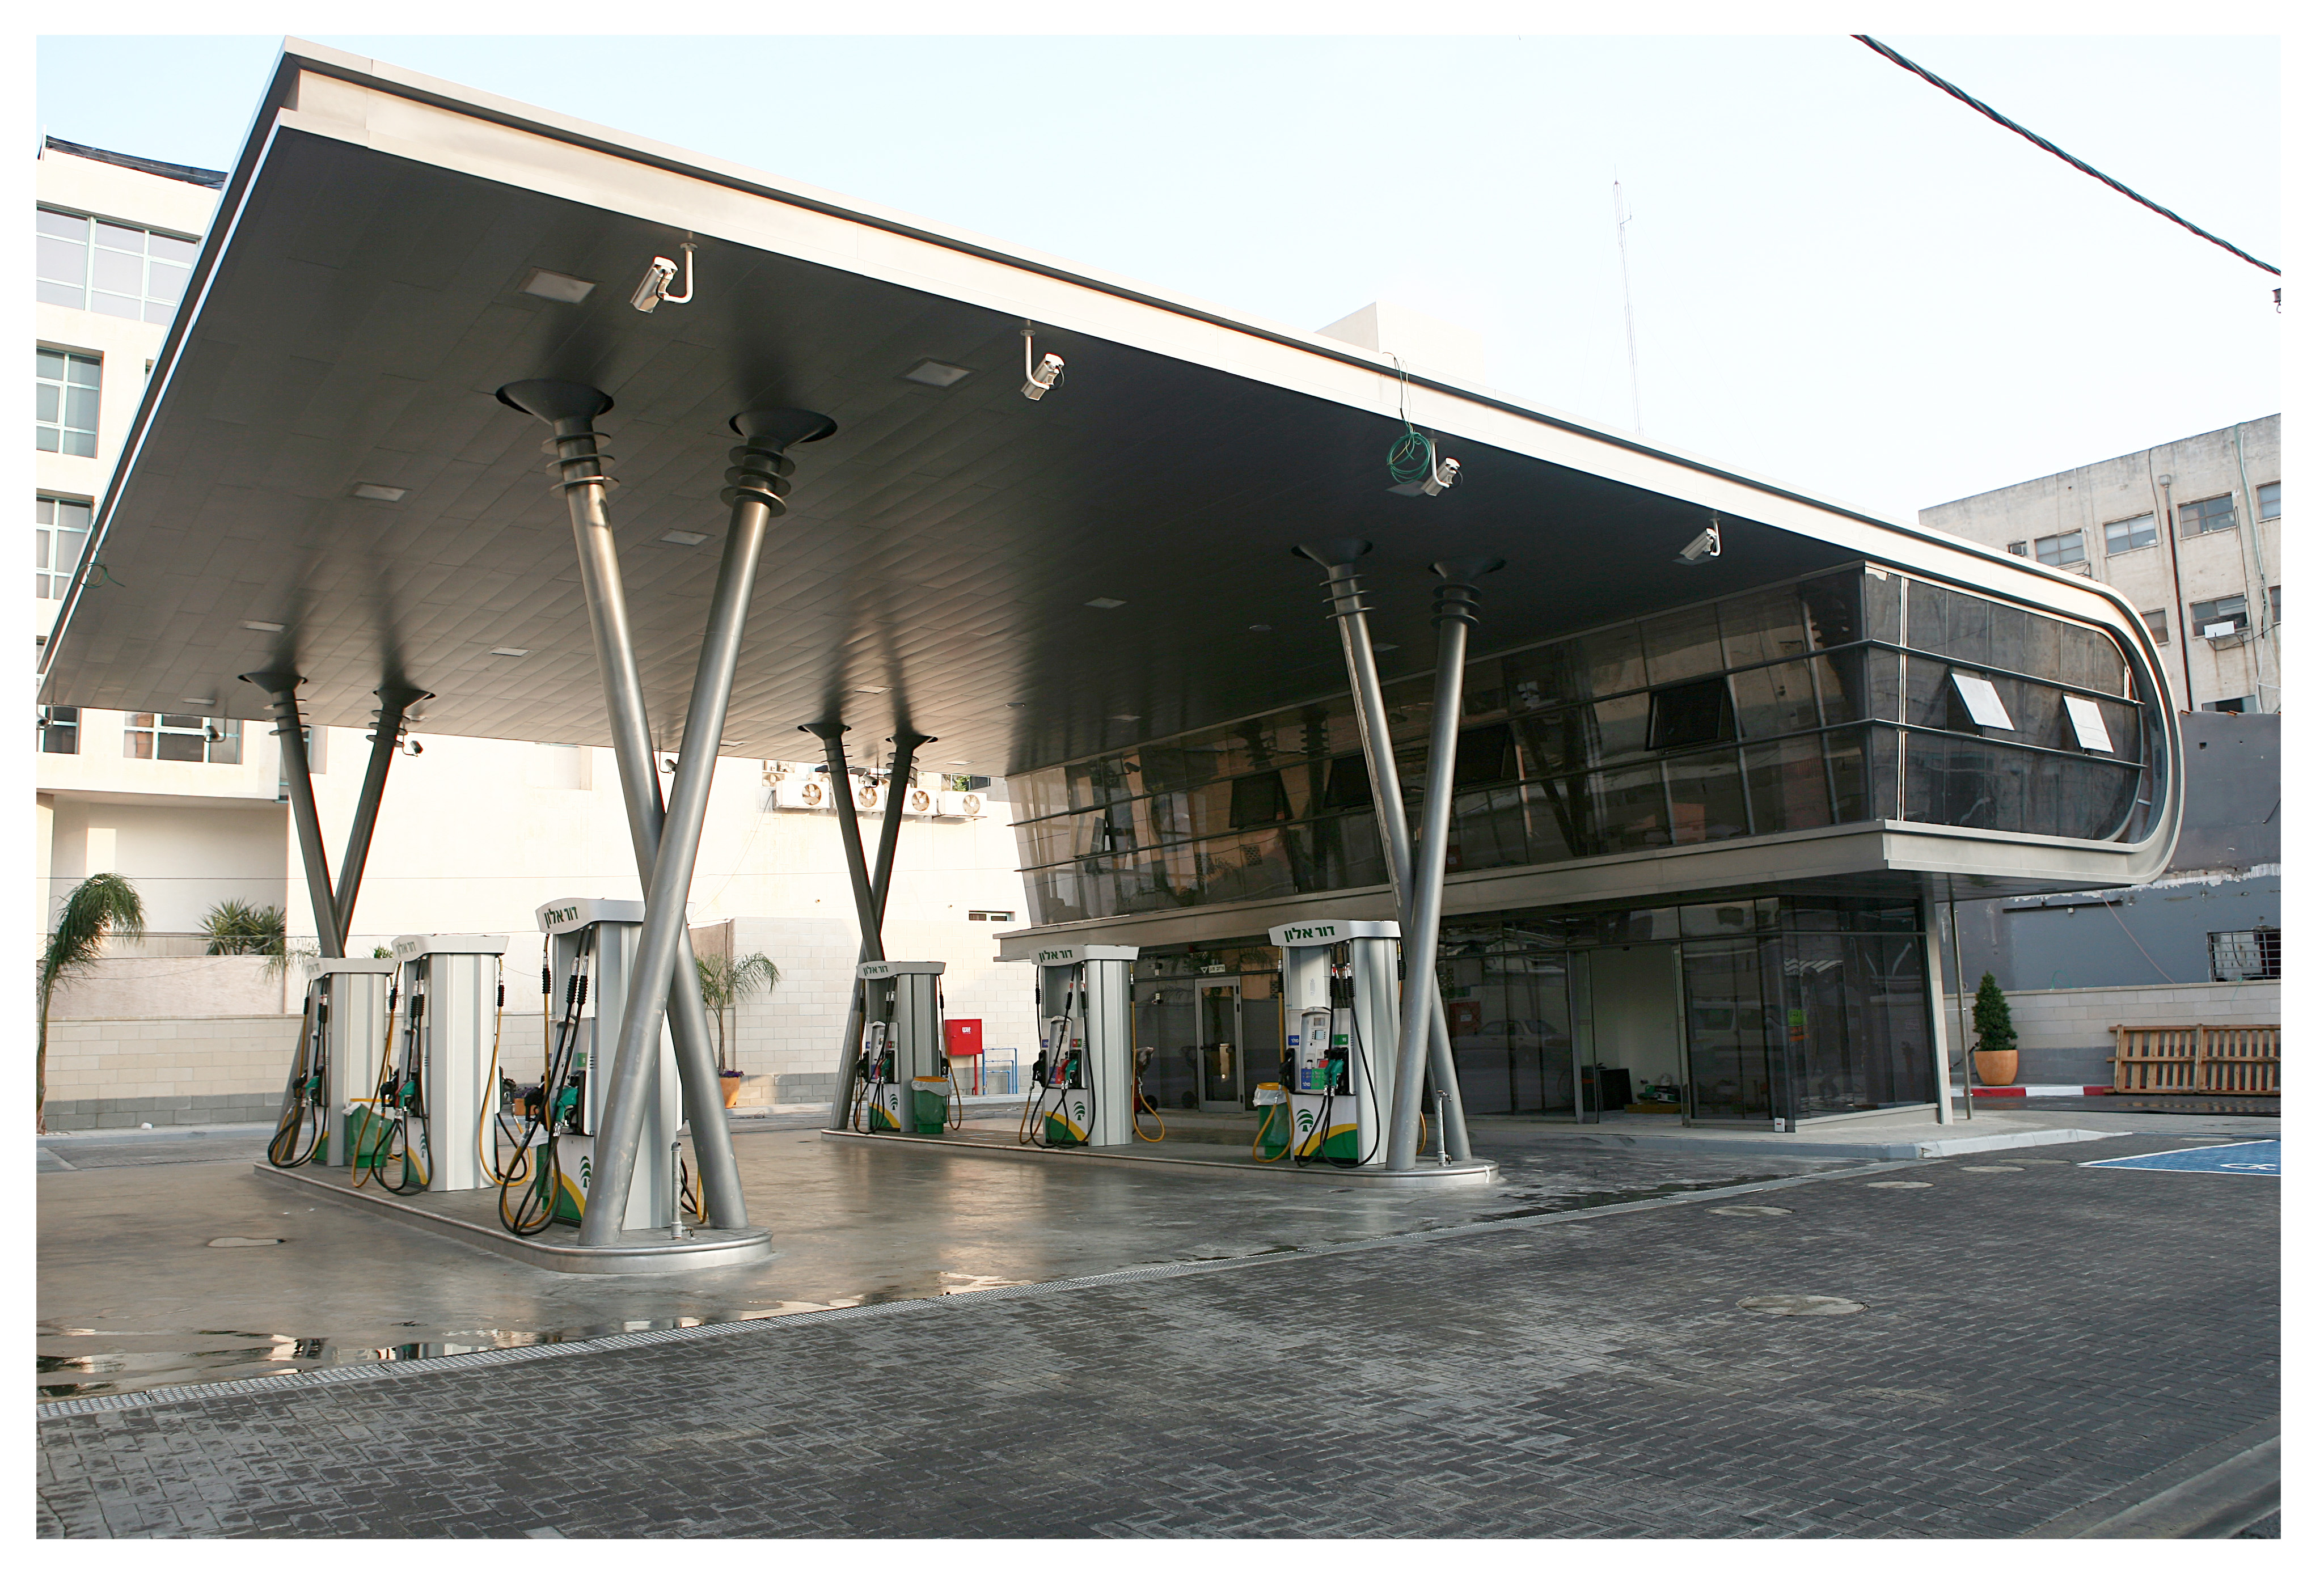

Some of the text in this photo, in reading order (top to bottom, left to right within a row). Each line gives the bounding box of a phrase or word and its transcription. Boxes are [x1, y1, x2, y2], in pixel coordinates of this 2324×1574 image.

[544, 907, 578, 929] דור אלון
[1284, 926, 1335, 942] דור אלון
[1039, 950, 1073, 963] דור אלון
[863, 966, 878, 976] אלון
